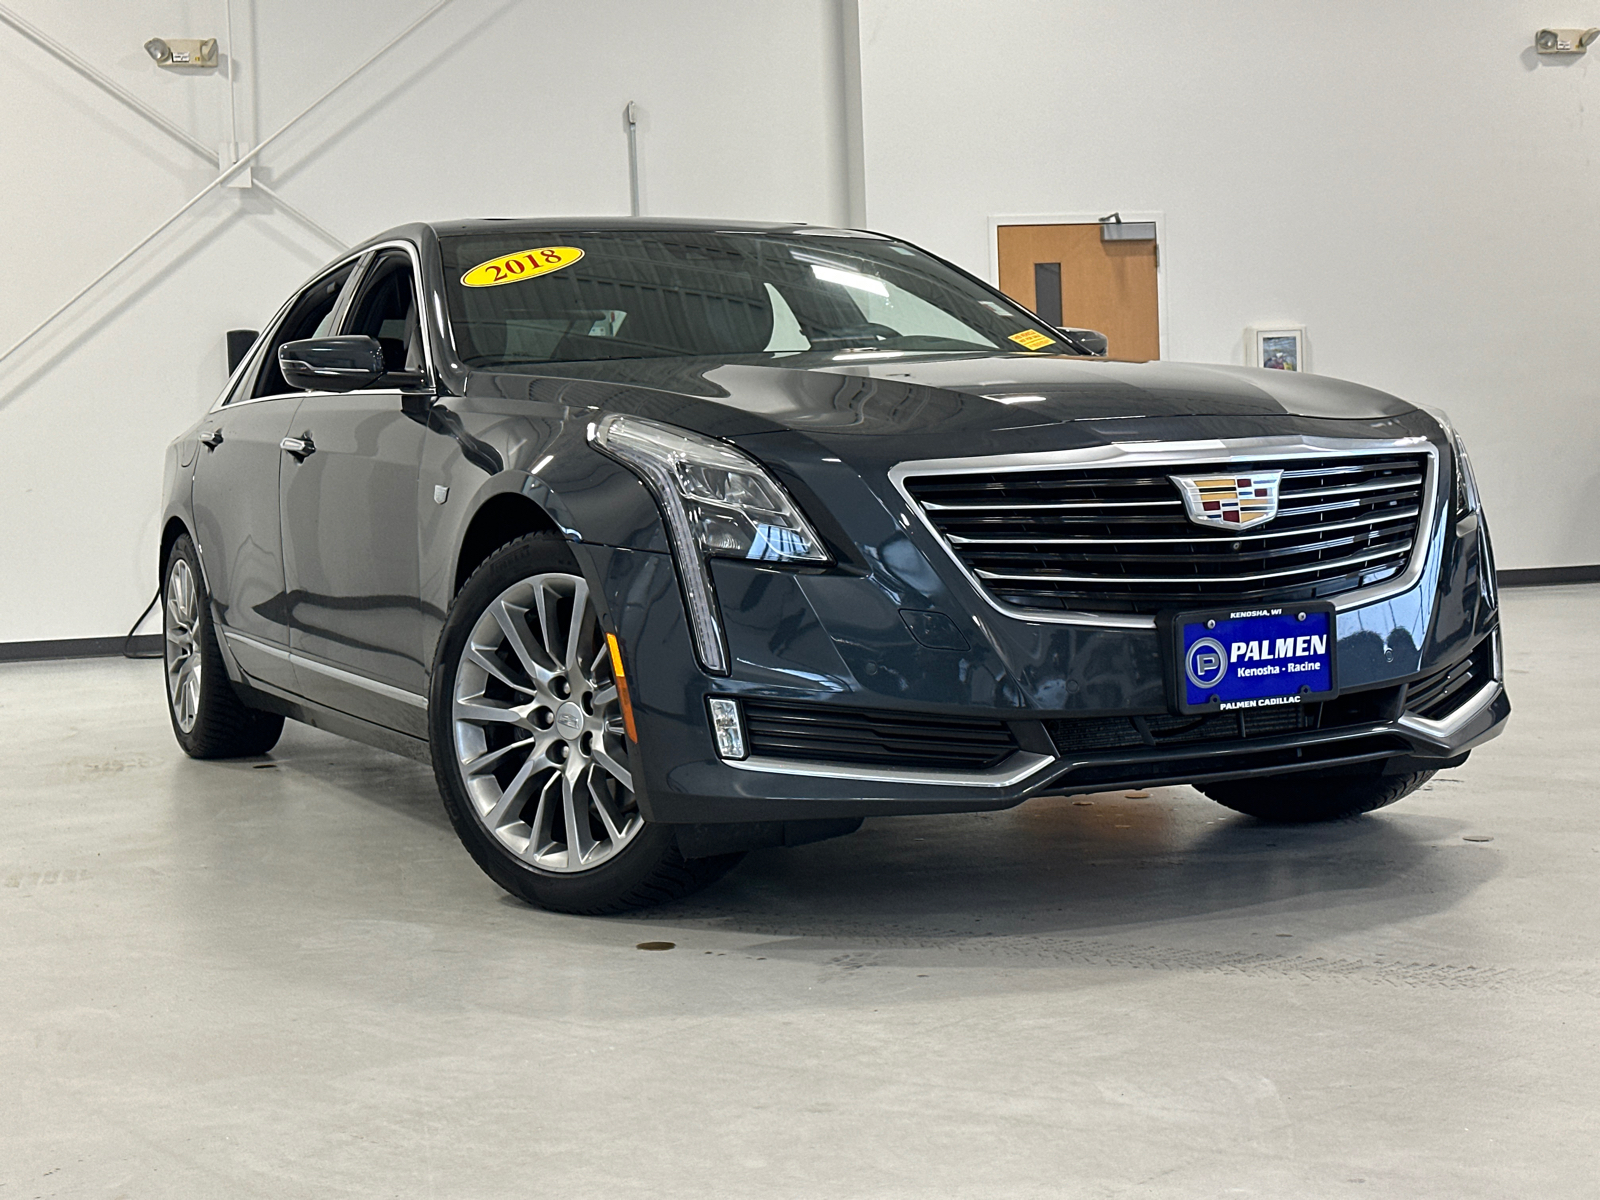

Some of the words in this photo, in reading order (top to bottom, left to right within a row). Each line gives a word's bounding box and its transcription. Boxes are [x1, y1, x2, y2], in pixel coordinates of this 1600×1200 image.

[485, 249, 562, 282] 2018
[1230, 609, 1270, 619] KENOSHA,
[1230, 634, 1327, 663] PALMEN
[1237, 664, 1280, 677] Kenosha
[1287, 661, 1321, 673] Racine
[1219, 700, 1257, 711] PALMEN
[1258, 695, 1301, 707] CADILLAC
